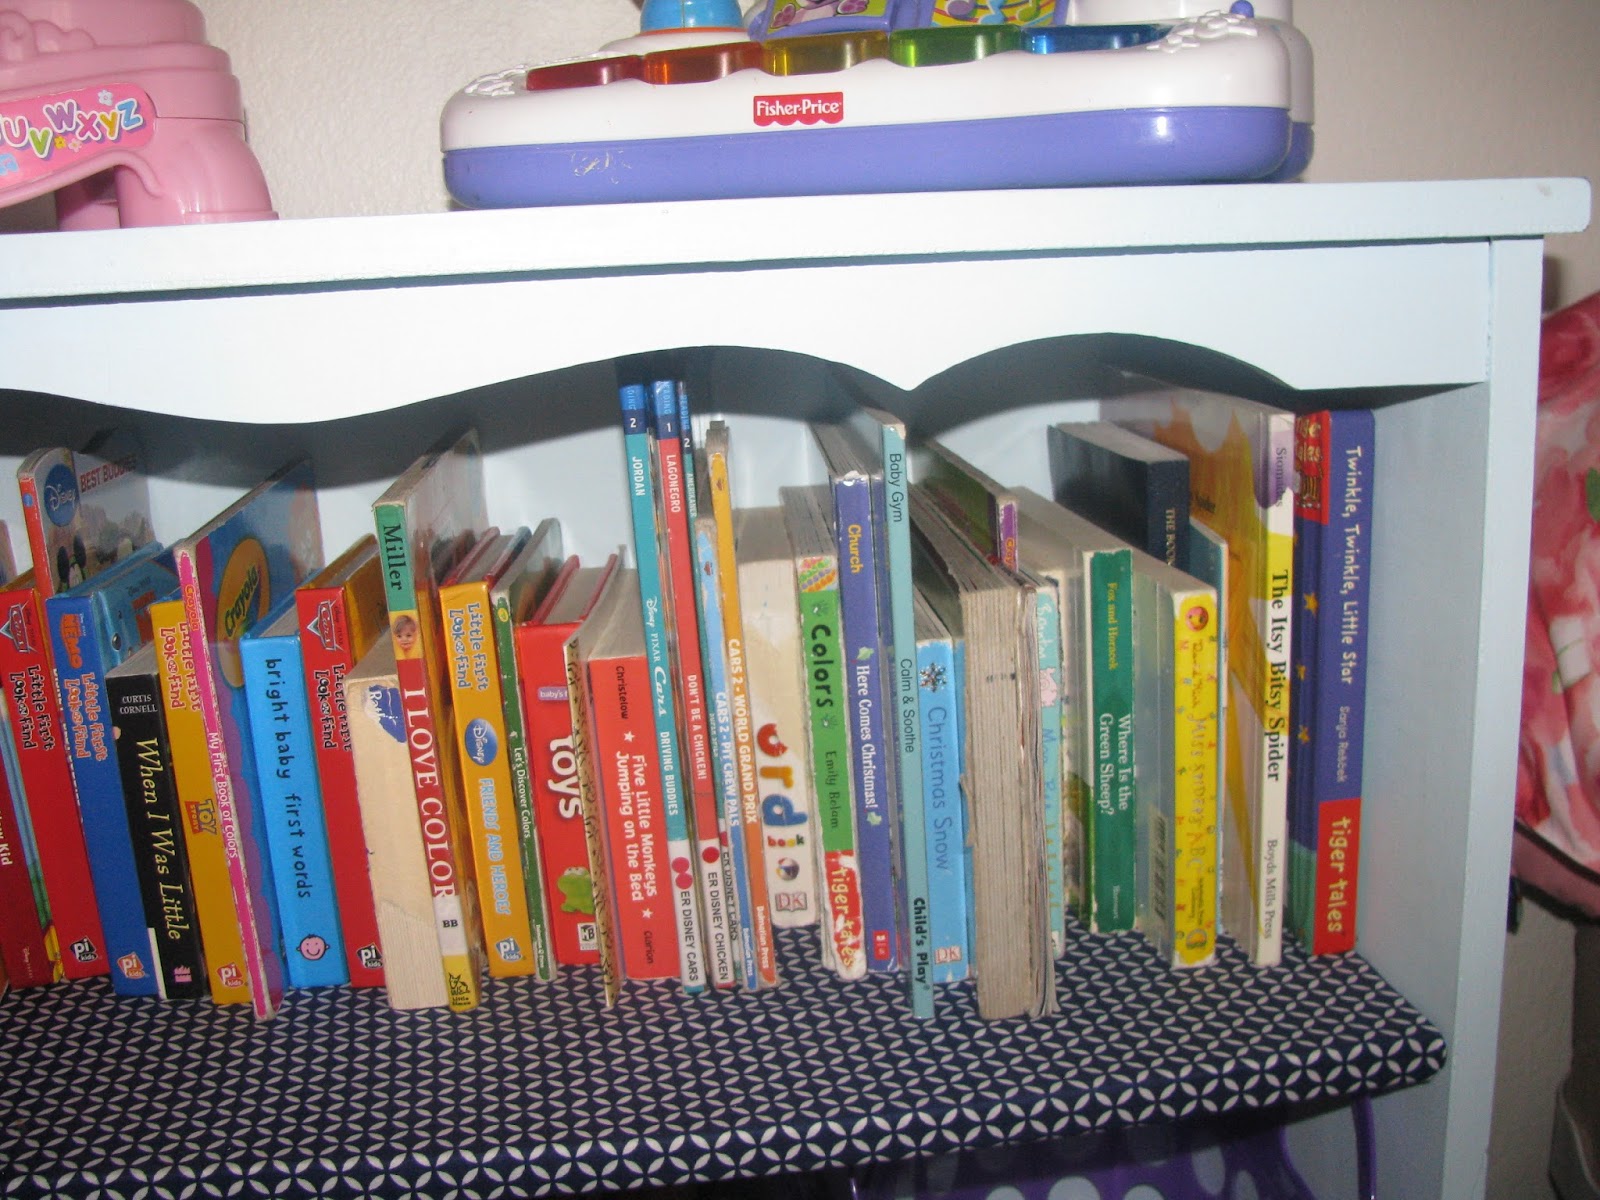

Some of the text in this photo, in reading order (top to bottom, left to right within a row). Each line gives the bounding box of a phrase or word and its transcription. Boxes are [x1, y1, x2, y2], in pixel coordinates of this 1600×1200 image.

[756, 99, 840, 116] Fisher-Price
[630, 417, 637, 428] 2
[667, 422, 672, 432] 1
[684, 437, 691, 448] 2
[80, 467, 101, 493] BEST
[632, 456, 645, 497] JORDAN
[666, 454, 681, 513] LAGONEGRO
[686, 473, 698, 518] AMERIKANER
[888, 453, 904, 523] Baby Gym
[1165, 507, 1176, 533] THE
[383, 524, 407, 590] Miller
[848, 524, 864, 574] Church
[1339, 446, 1362, 685] Twinkle, Twinkle, Little Star
[450, 609, 472, 690] Look find
[467, 602, 484, 650] Little
[646, 597, 662, 662] Disney PIXAR
[27, 664, 47, 711] Little
[160, 627, 186, 709] Look find
[314, 670, 331, 704] Look
[688, 674, 700, 704] DON'T
[811, 624, 834, 708] Colors
[1264, 569, 1289, 781] The Itsy Bitsy Spider
[9, 671, 28, 703] Look
[20, 715, 37, 750] find
[82, 672, 101, 722] Little
[120, 704, 158, 714] CORNELL
[122, 694, 152, 704] CURTIS
[404, 687, 426, 700] I
[540, 686, 564, 698] baby's
[615, 665, 629, 720] Christelow
[654, 666, 667, 717] Cars
[691, 708, 702, 722] BE
[901, 658, 917, 753] Calm & Soothe
[64, 678, 82, 709] Look
[73, 723, 91, 759] find
[321, 714, 337, 749] find
[728, 638, 758, 824] CARS 2 WORLD GRAND PRIX
[856, 665, 879, 809] Here Comes Christmas!
[407, 708, 439, 788] LOVE
[472, 724, 491, 764] Disney
[514, 747, 523, 768] Let's
[694, 734, 707, 780] CHICKEN!
[716, 692, 740, 826] CARS 2 PIT CREW PALS
[825, 751, 840, 786] Emily
[1097, 713, 1115, 816] Green Sheep?
[1118, 713, 1131, 810] Where Is the
[208, 732, 238, 858] My First Book of Colors
[265, 658, 310, 898] bright baby first words
[516, 769, 527, 811] Discover
[660, 731, 678, 816] DRIVING BUDDIES
[757, 723, 808, 826] ord
[928, 706, 953, 871] Christmas Snow
[136, 737, 190, 940] When I Was Little
[190, 804, 199, 832] STORY
[199, 798, 217, 836] TOY
[522, 809, 531, 838] Colors
[616, 751, 644, 902] Jumping on the Bed
[632, 754, 657, 896] Five Little Monkeys
[767, 834, 804, 847] book
[478, 777, 511, 915] FRIENDS AND HEROES
[832, 867, 849, 915] tiger
[1264, 839, 1278, 939] Boyds Mills Press
[1327, 816, 1352, 933] tiger tales
[442, 919, 458, 928] BB
[499, 938, 515, 957] pi
[644, 930, 654, 964] Clarion
[681, 891, 698, 982] ER DISNEY CARS
[708, 872, 728, 980] ER DISNEY CHICKEN
[913, 897, 930, 984] Child's Play
[74, 939, 90, 961] pi
[122, 953, 137, 978] pi
[221, 963, 236, 986] pi
[360, 944, 376, 966] pi
[761, 947, 770, 969] Press
